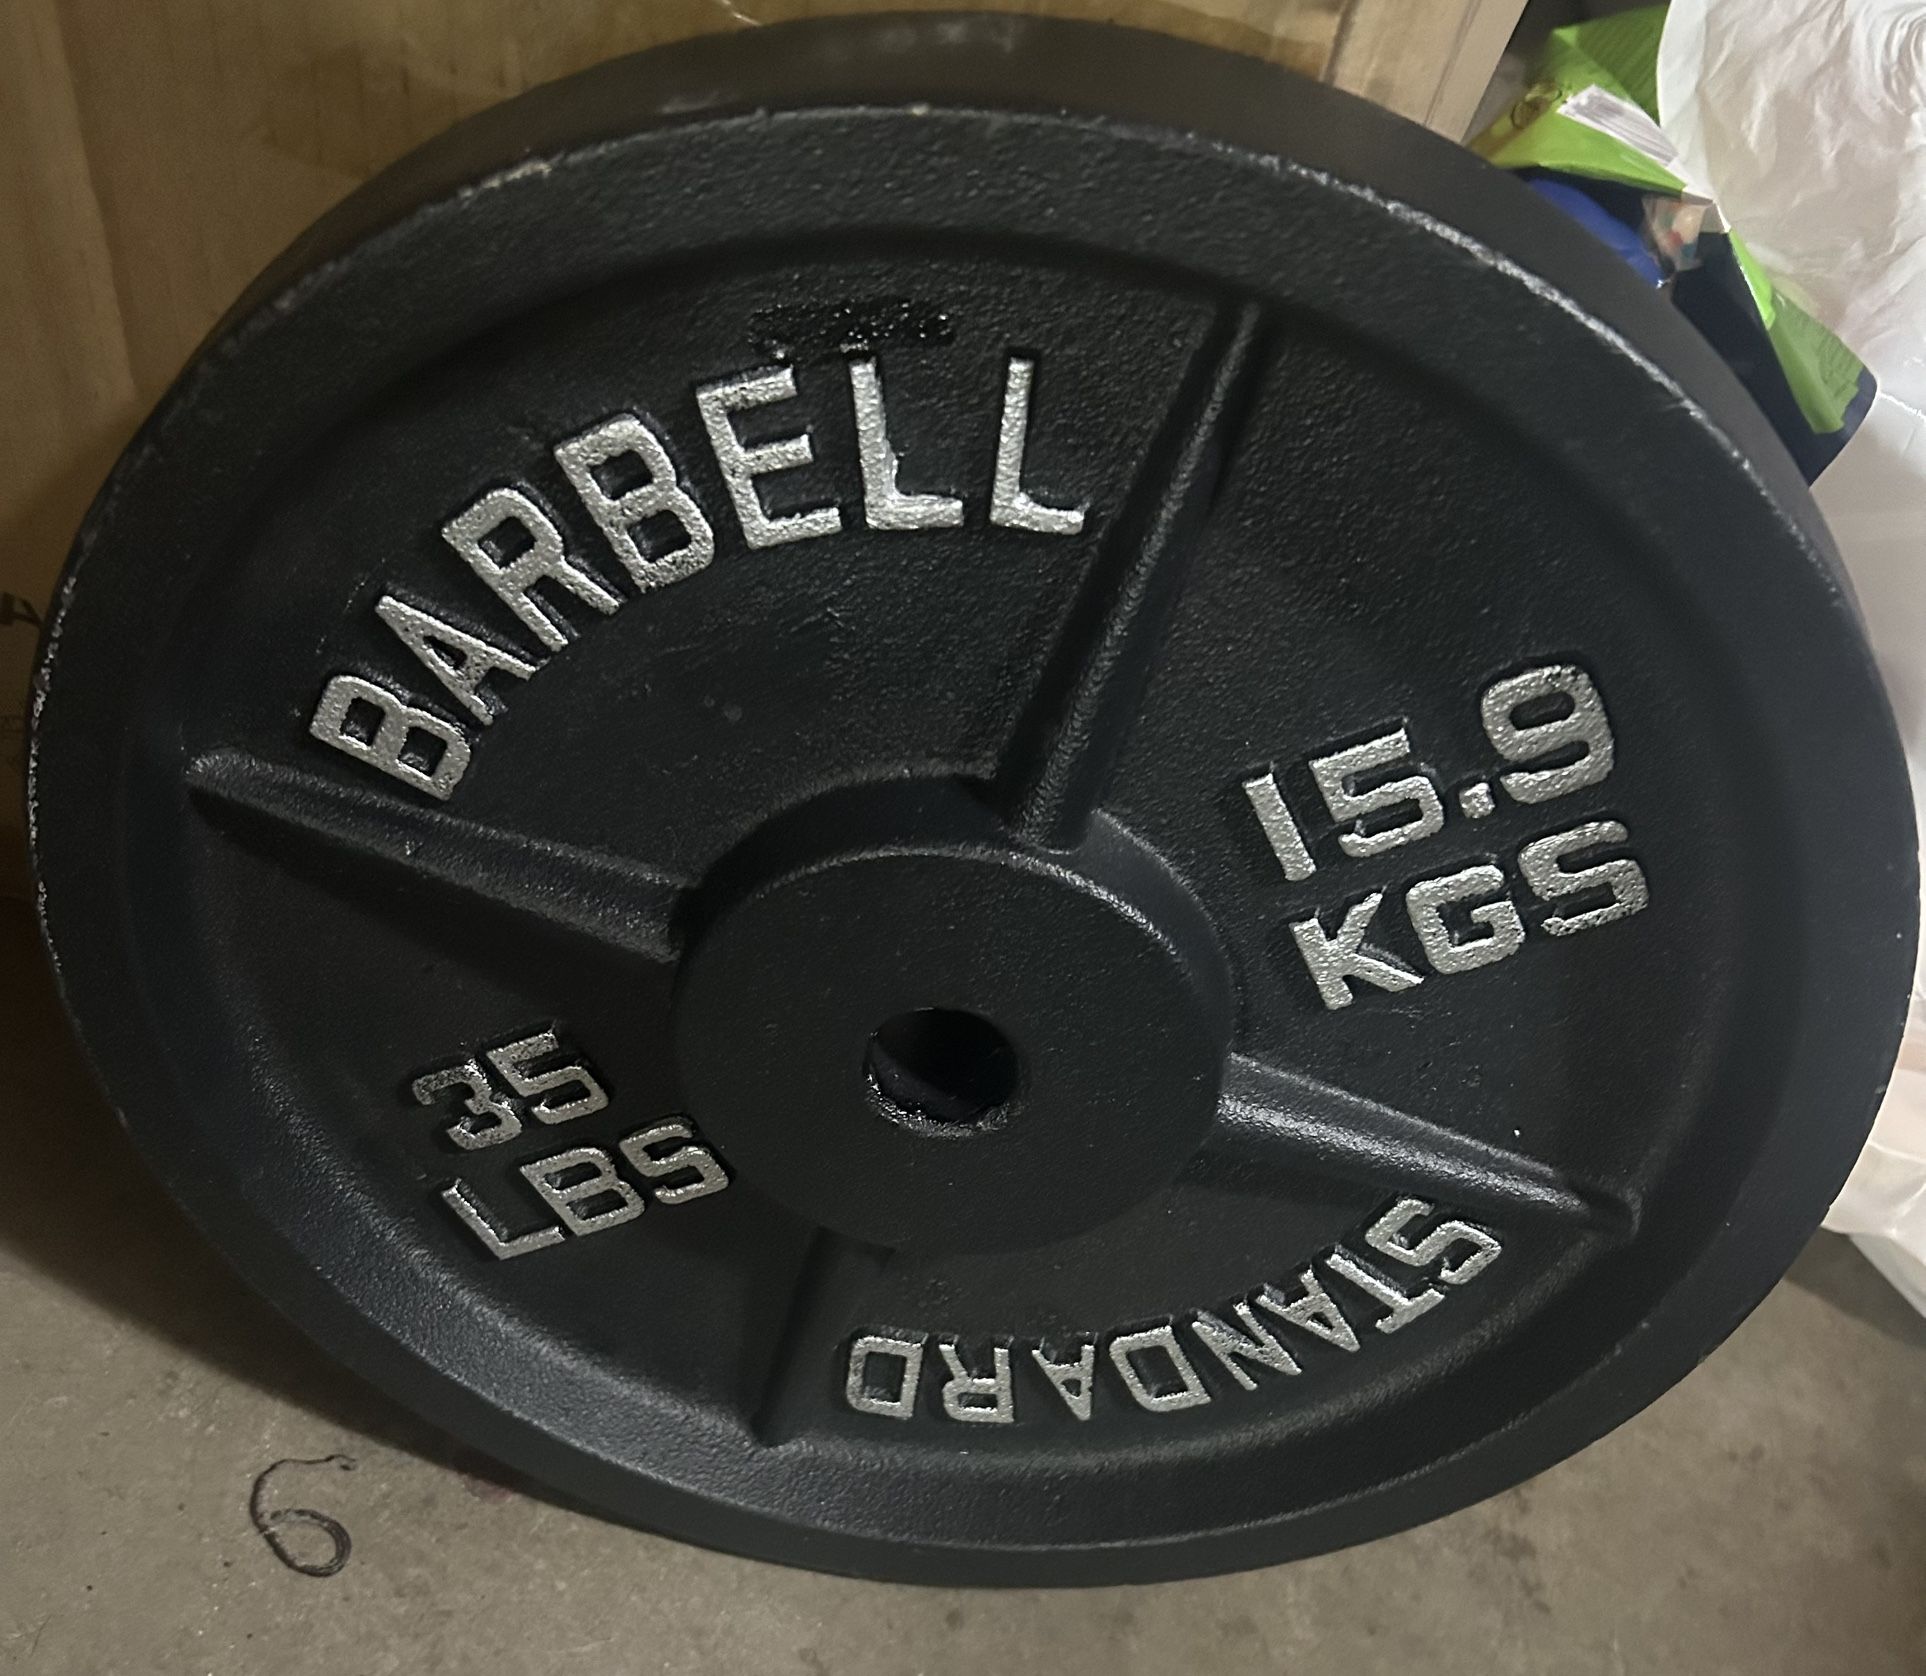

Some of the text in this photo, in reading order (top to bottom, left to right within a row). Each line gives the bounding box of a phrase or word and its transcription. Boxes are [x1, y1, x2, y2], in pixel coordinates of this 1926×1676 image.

[309, 356, 1087, 800] BARBELL
[1242, 663, 1615, 881] 15.9
[1289, 819, 1651, 1011] KGS
[411, 1028, 609, 1150] 35
[440, 1124, 730, 1260] LBS
[845, 1197, 1502, 1423] STANDARD
